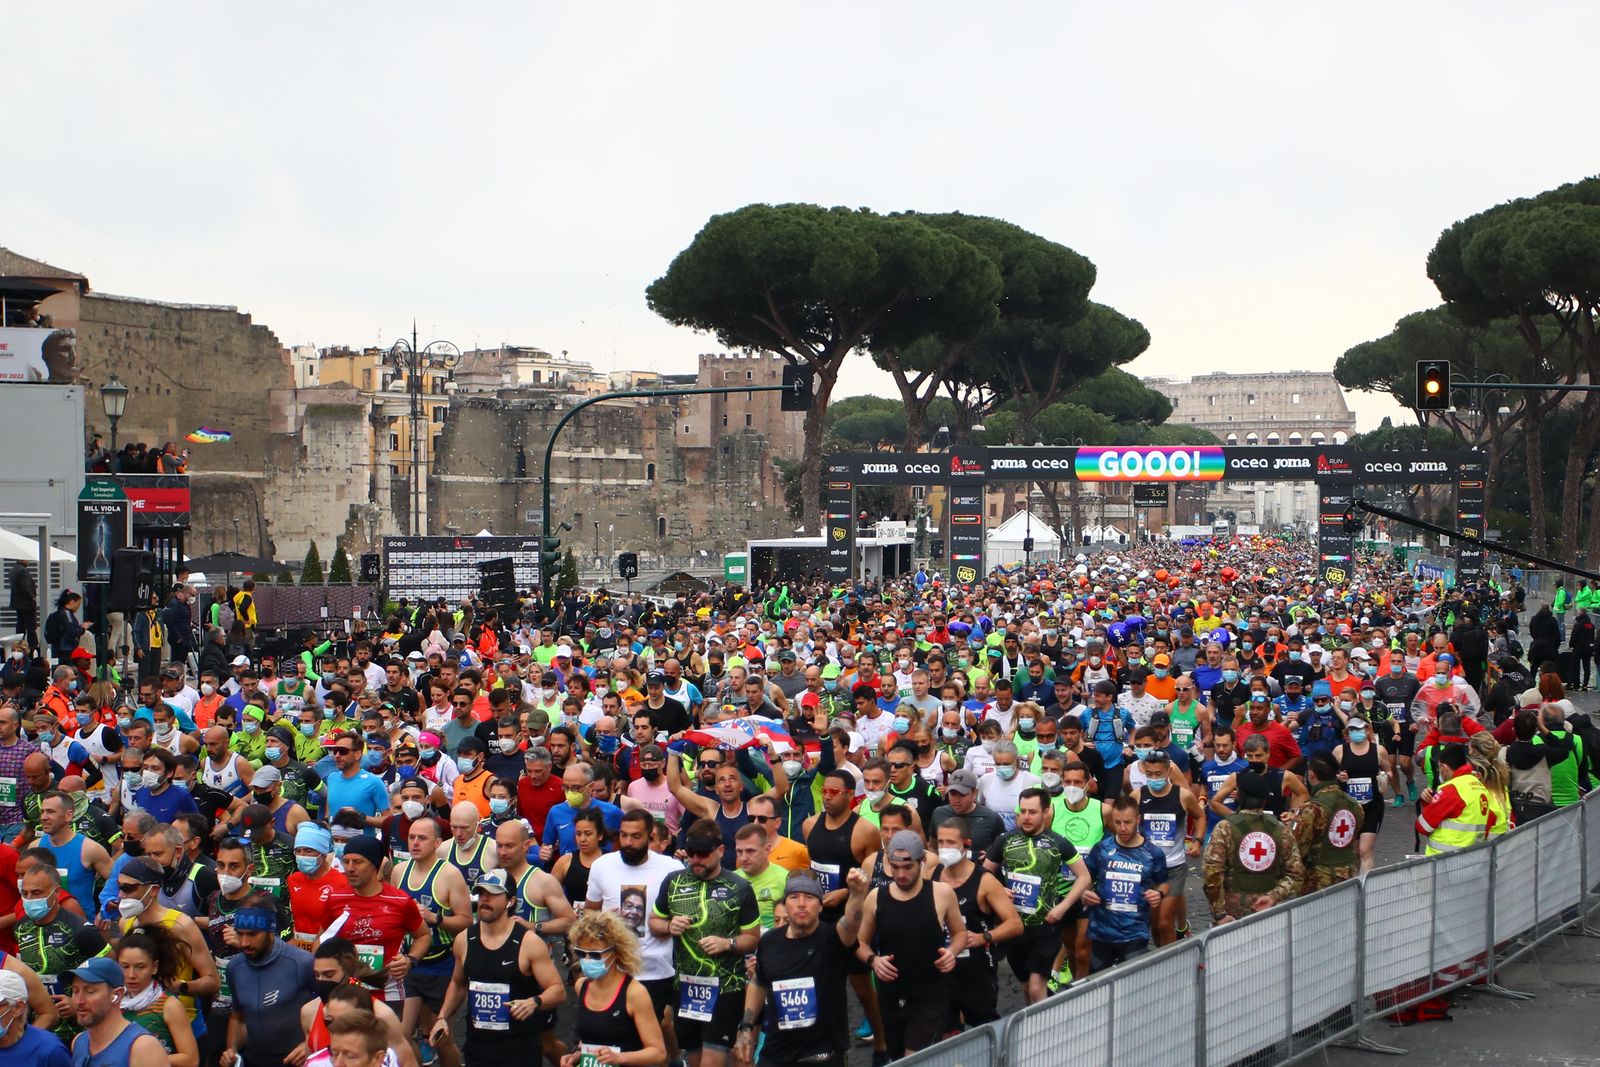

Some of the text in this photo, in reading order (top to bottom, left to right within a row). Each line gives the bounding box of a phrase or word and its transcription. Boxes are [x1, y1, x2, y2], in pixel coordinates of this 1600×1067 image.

[905, 463, 940, 474] acea
[1032, 459, 1069, 470] acea
[1099, 450, 1201, 478] GOOO!
[1231, 458, 1268, 469] acea
[1365, 461, 1402, 472] acea
[959, 571, 974, 579] 105
[1328, 572, 1343, 581] 105
[1150, 821, 1170, 831] 8378
[1112, 860, 1144, 872] FRANCE
[1011, 881, 1033, 896] 6643
[1111, 880, 1134, 893] 5312
[688, 985, 712, 1000] 6135
[780, 989, 808, 1007] 5466
[475, 993, 502, 1009] 2853
